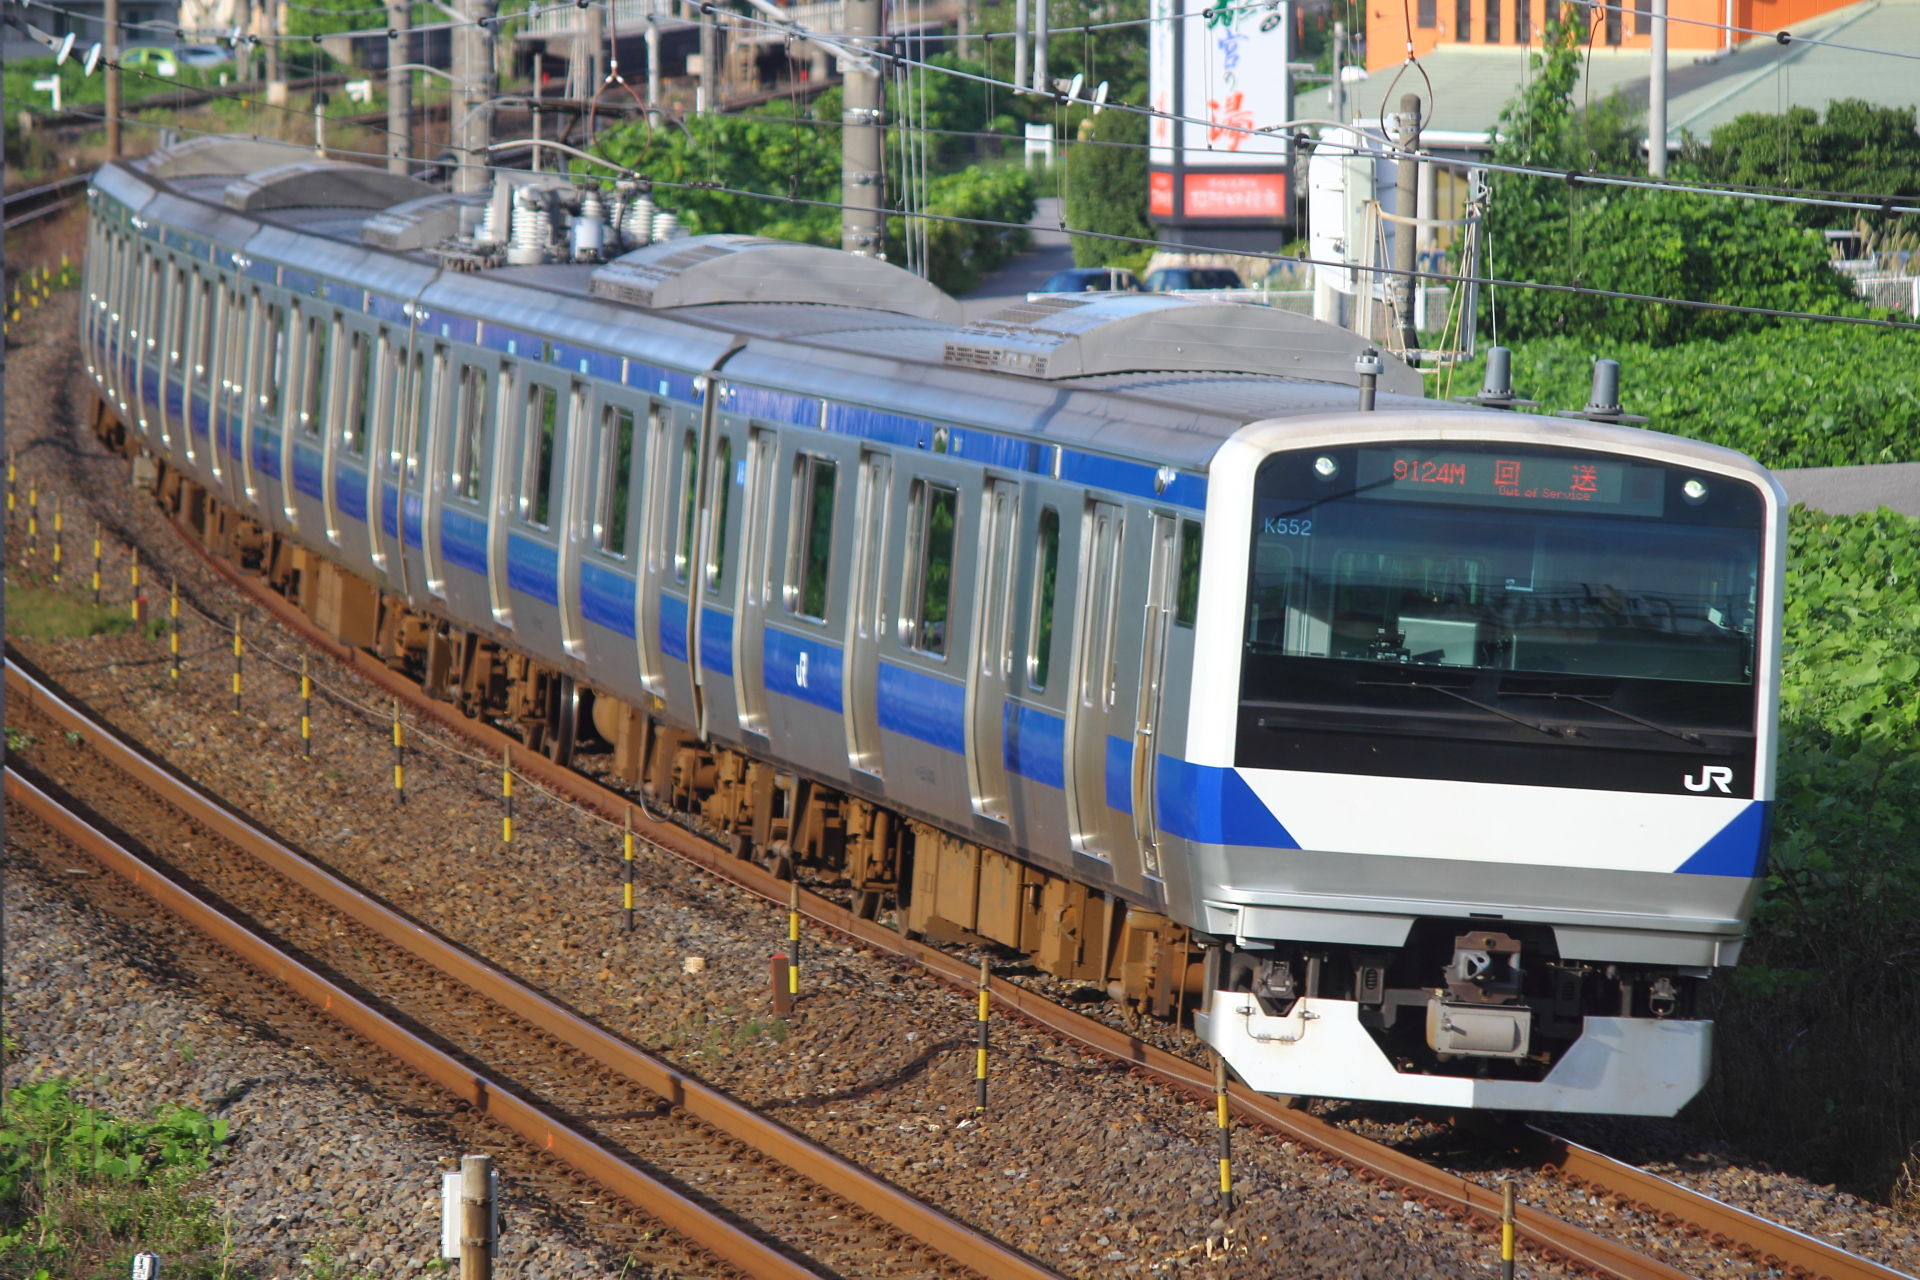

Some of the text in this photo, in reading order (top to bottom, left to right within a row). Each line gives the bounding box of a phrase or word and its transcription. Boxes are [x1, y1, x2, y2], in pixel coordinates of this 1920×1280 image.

[1392, 459, 1467, 485] 9124M
[1498, 486, 1592, 501] Out of Service
[1264, 517, 1312, 537] K552
[795, 651, 809, 689] JR
[1683, 765, 1734, 794] JR
